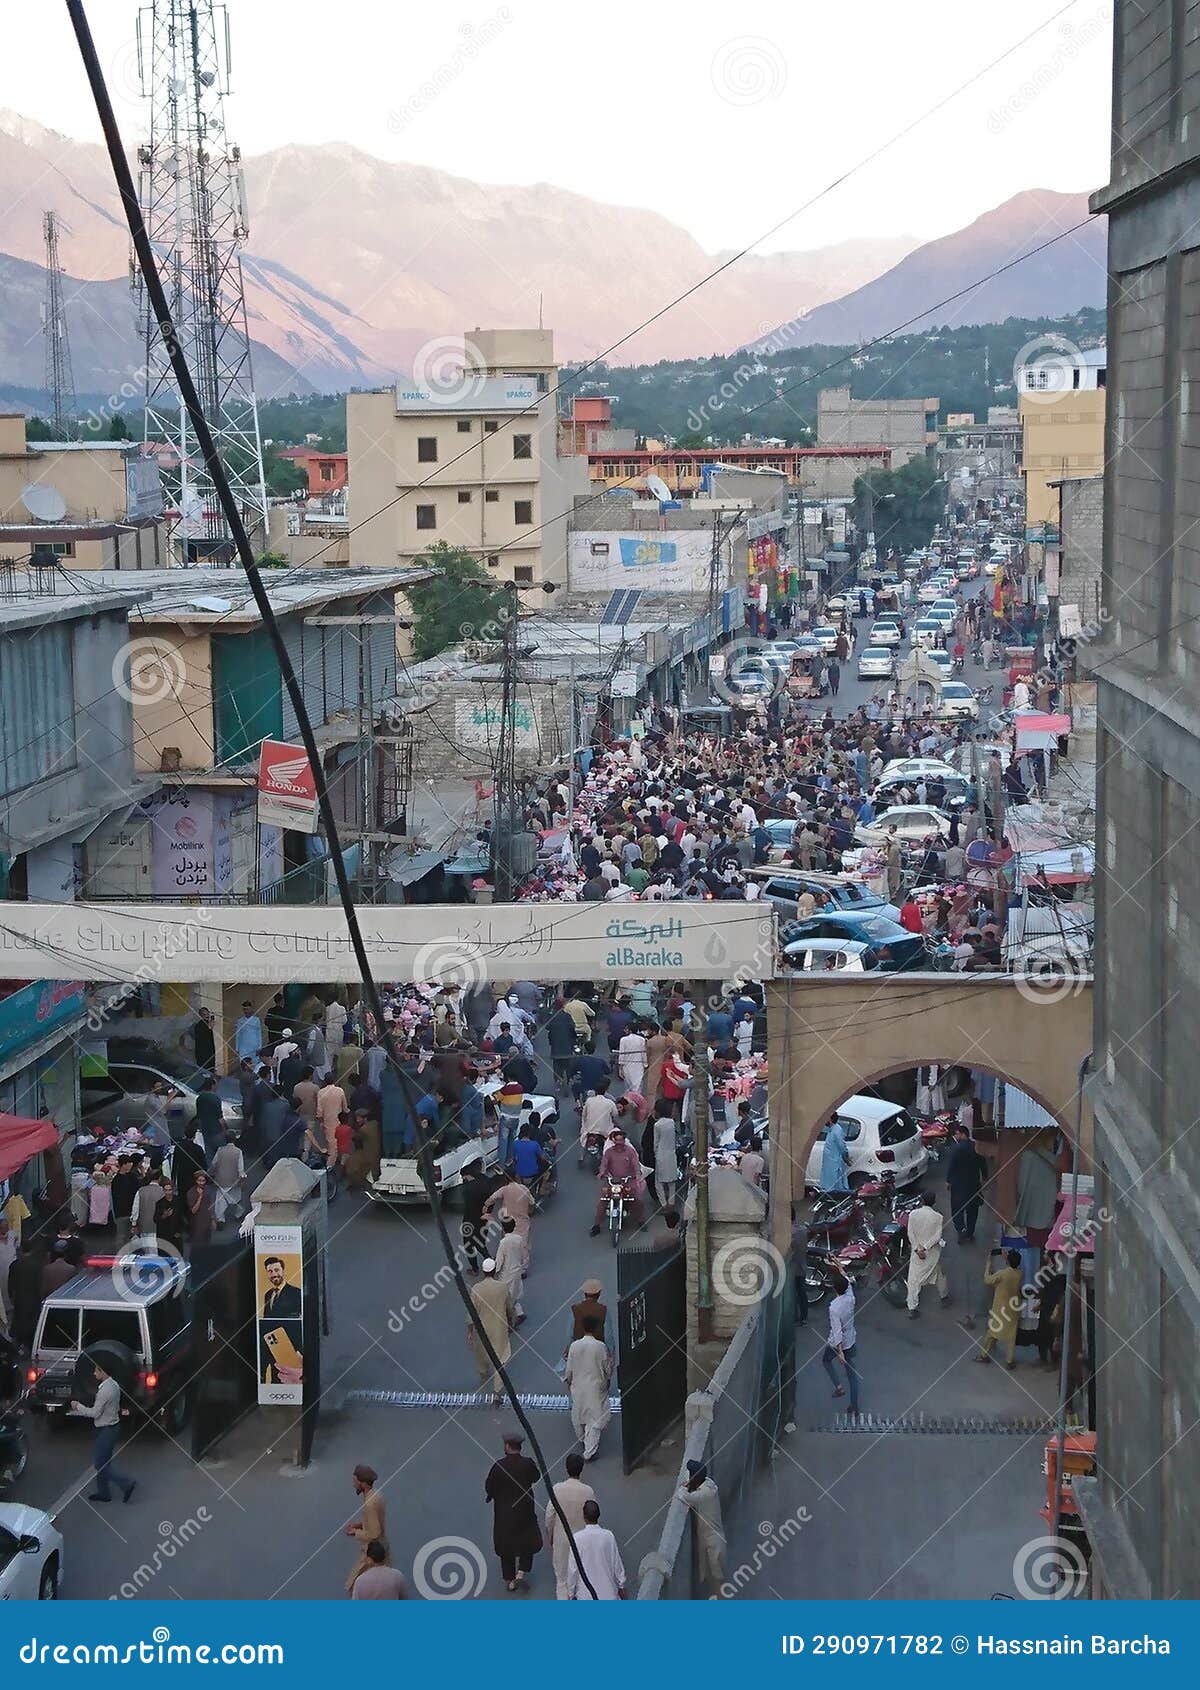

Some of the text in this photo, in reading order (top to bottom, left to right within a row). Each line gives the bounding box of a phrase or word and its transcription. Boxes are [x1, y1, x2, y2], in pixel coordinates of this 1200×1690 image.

[266, 779, 308, 796] HONDA
[170, 841, 204, 850] Mobilink
[77, 920, 236, 960] Shopping
[606, 947, 683, 967] alBaraka
